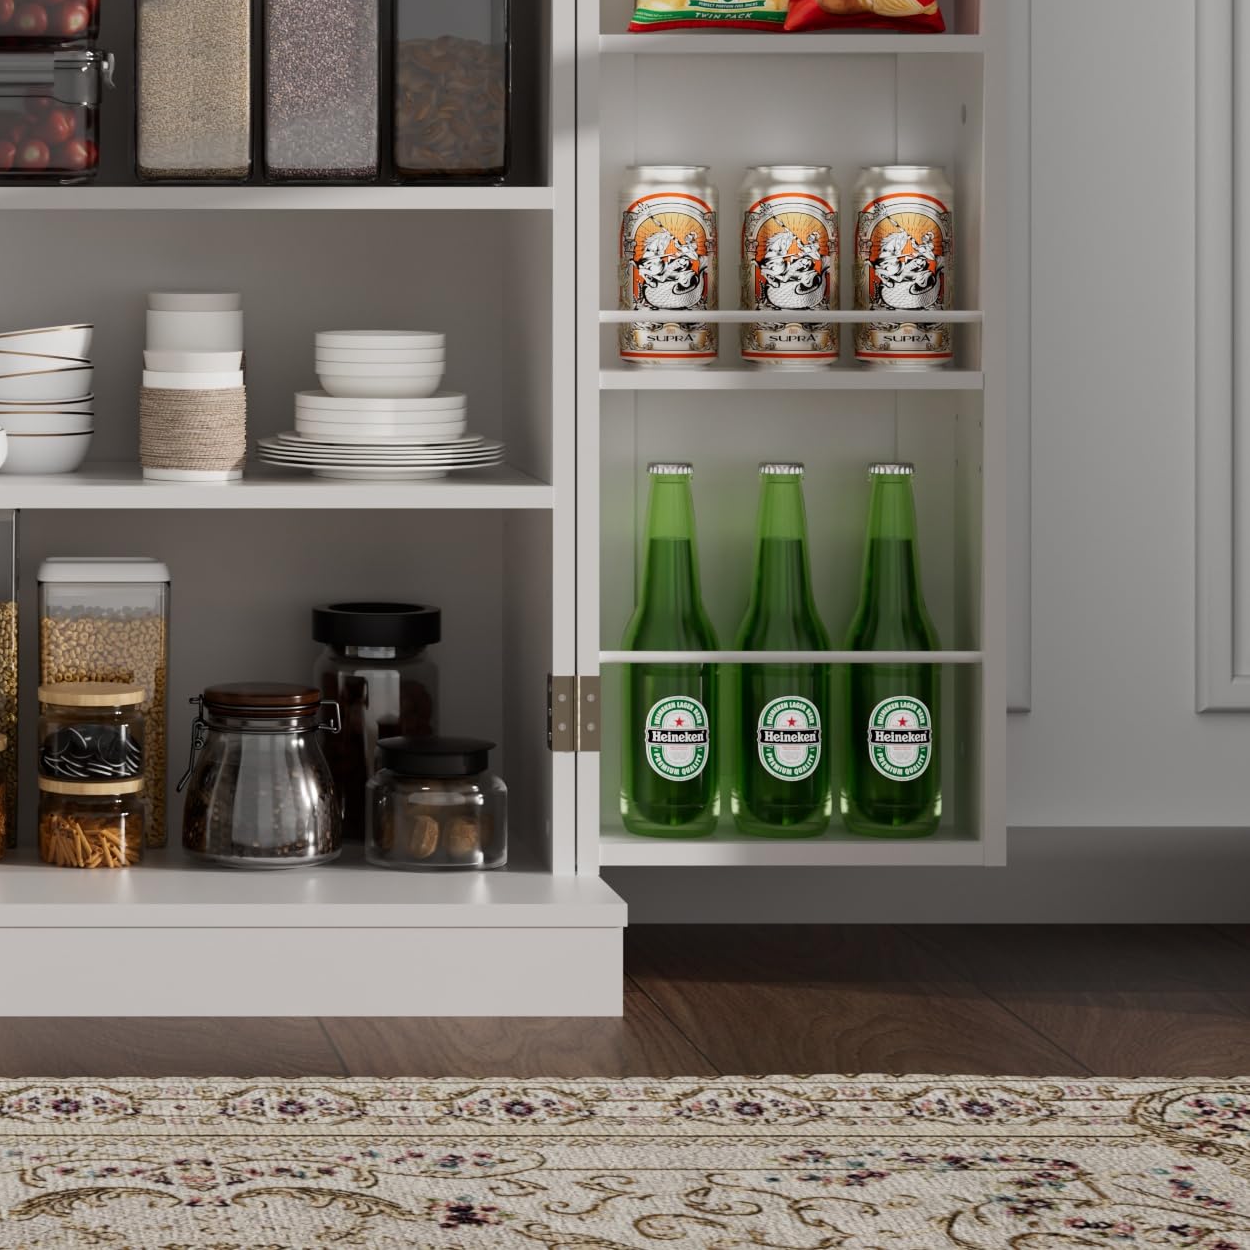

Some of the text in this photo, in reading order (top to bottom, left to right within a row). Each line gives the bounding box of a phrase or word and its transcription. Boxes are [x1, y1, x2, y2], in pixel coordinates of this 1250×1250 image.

[647, 333, 694, 342] SUPRA
[769, 333, 816, 342] SUPRA
[883, 334, 932, 343] SUPRA
[676, 701, 694, 711] LAGER
[790, 701, 807, 711] LAGER
[900, 701, 918, 711] LAGER
[652, 731, 704, 742] Heineken
[764, 731, 816, 742] Heineken
[875, 731, 927, 742] Heineken
